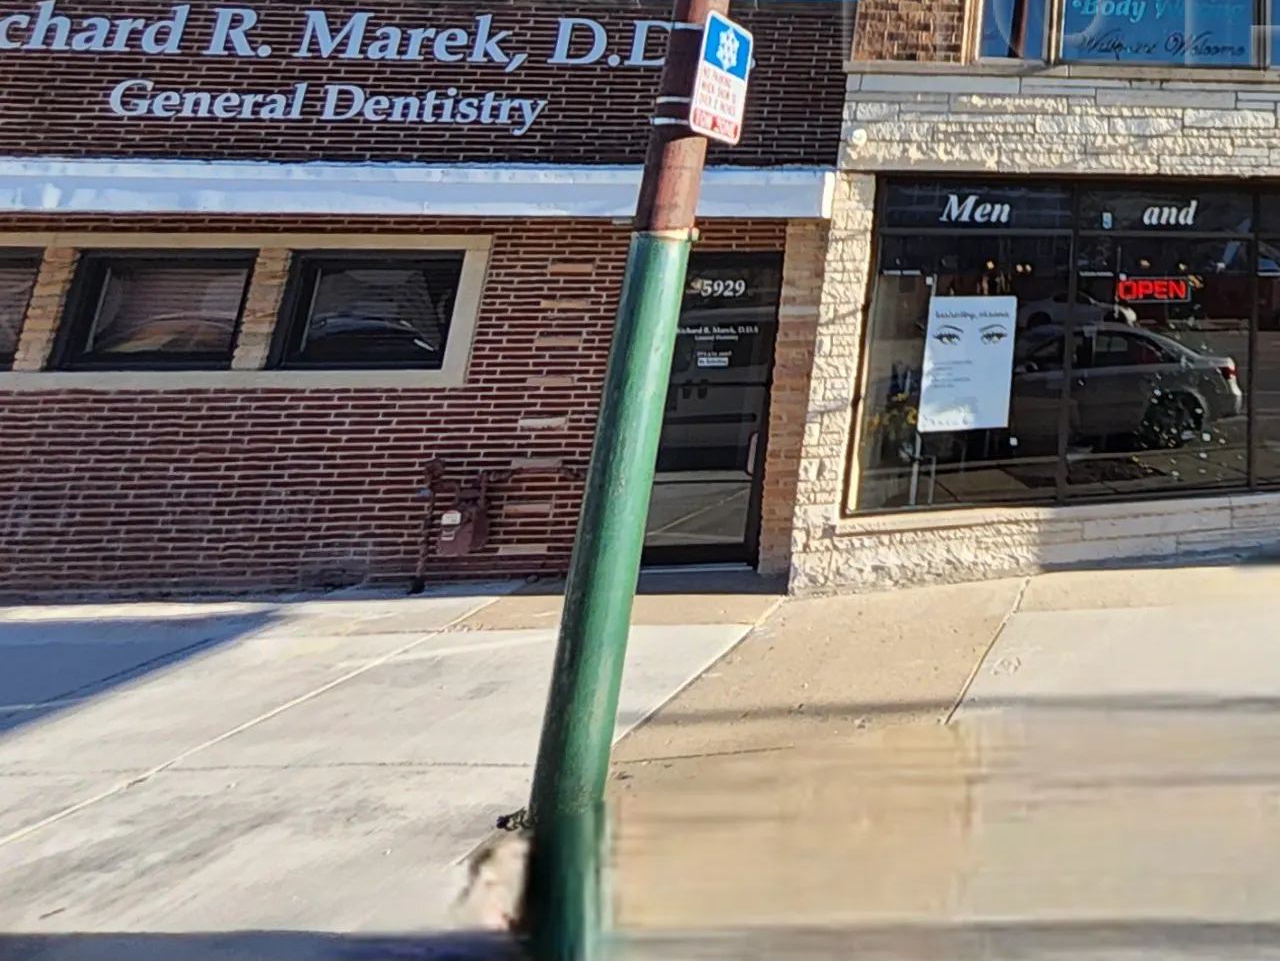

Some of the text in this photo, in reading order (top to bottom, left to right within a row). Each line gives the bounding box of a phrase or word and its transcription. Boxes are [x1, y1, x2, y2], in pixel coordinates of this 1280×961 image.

[0, 0, 191, 55] chard
[202, 7, 272, 57] R.
[294, 10, 530, 74] Marek,
[109, 78, 549, 136] General Dentistry
[939, 193, 1011, 224] Men
[1143, 199, 1198, 226] and
[700, 279, 746, 297] 5929
[1118, 278, 1187, 300] OPEN
